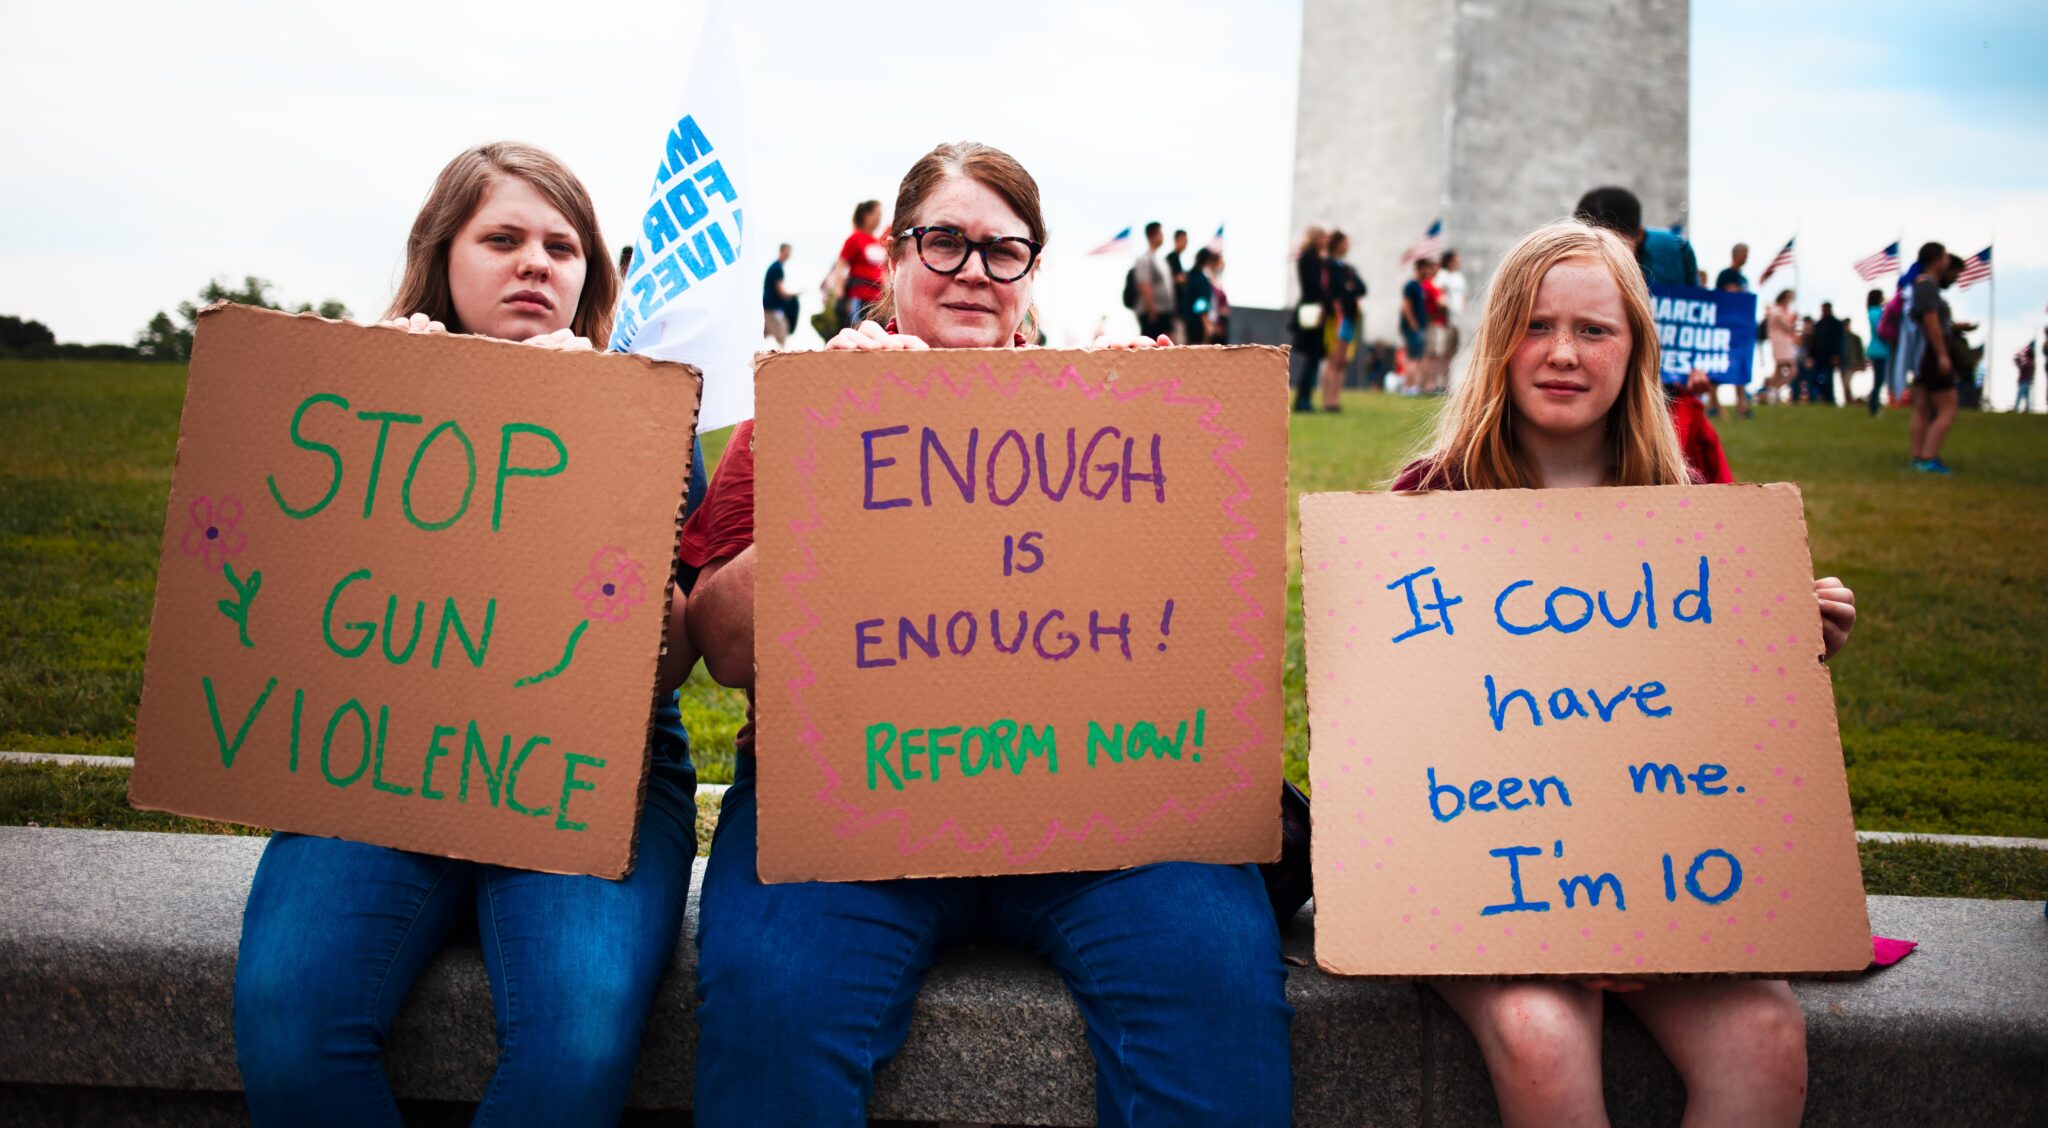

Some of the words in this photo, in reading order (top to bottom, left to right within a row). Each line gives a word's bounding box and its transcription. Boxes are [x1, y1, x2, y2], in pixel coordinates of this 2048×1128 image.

[1679, 325, 1731, 352] OUR
[267, 393, 569, 532] STOP
[861, 425, 1166, 511] ENOUGH
[1003, 531, 1044, 577] IS
[322, 569, 497, 669] GUN
[1386, 566, 1463, 644] It
[1484, 674, 1673, 732] have
[203, 676, 606, 832] VIOLENCE
[865, 718, 1059, 791] REFORM
[1427, 766, 1573, 823] been
[1628, 762, 1746, 796] me.
[1480, 840, 1627, 916] I'm
[1662, 848, 1743, 905] 10
